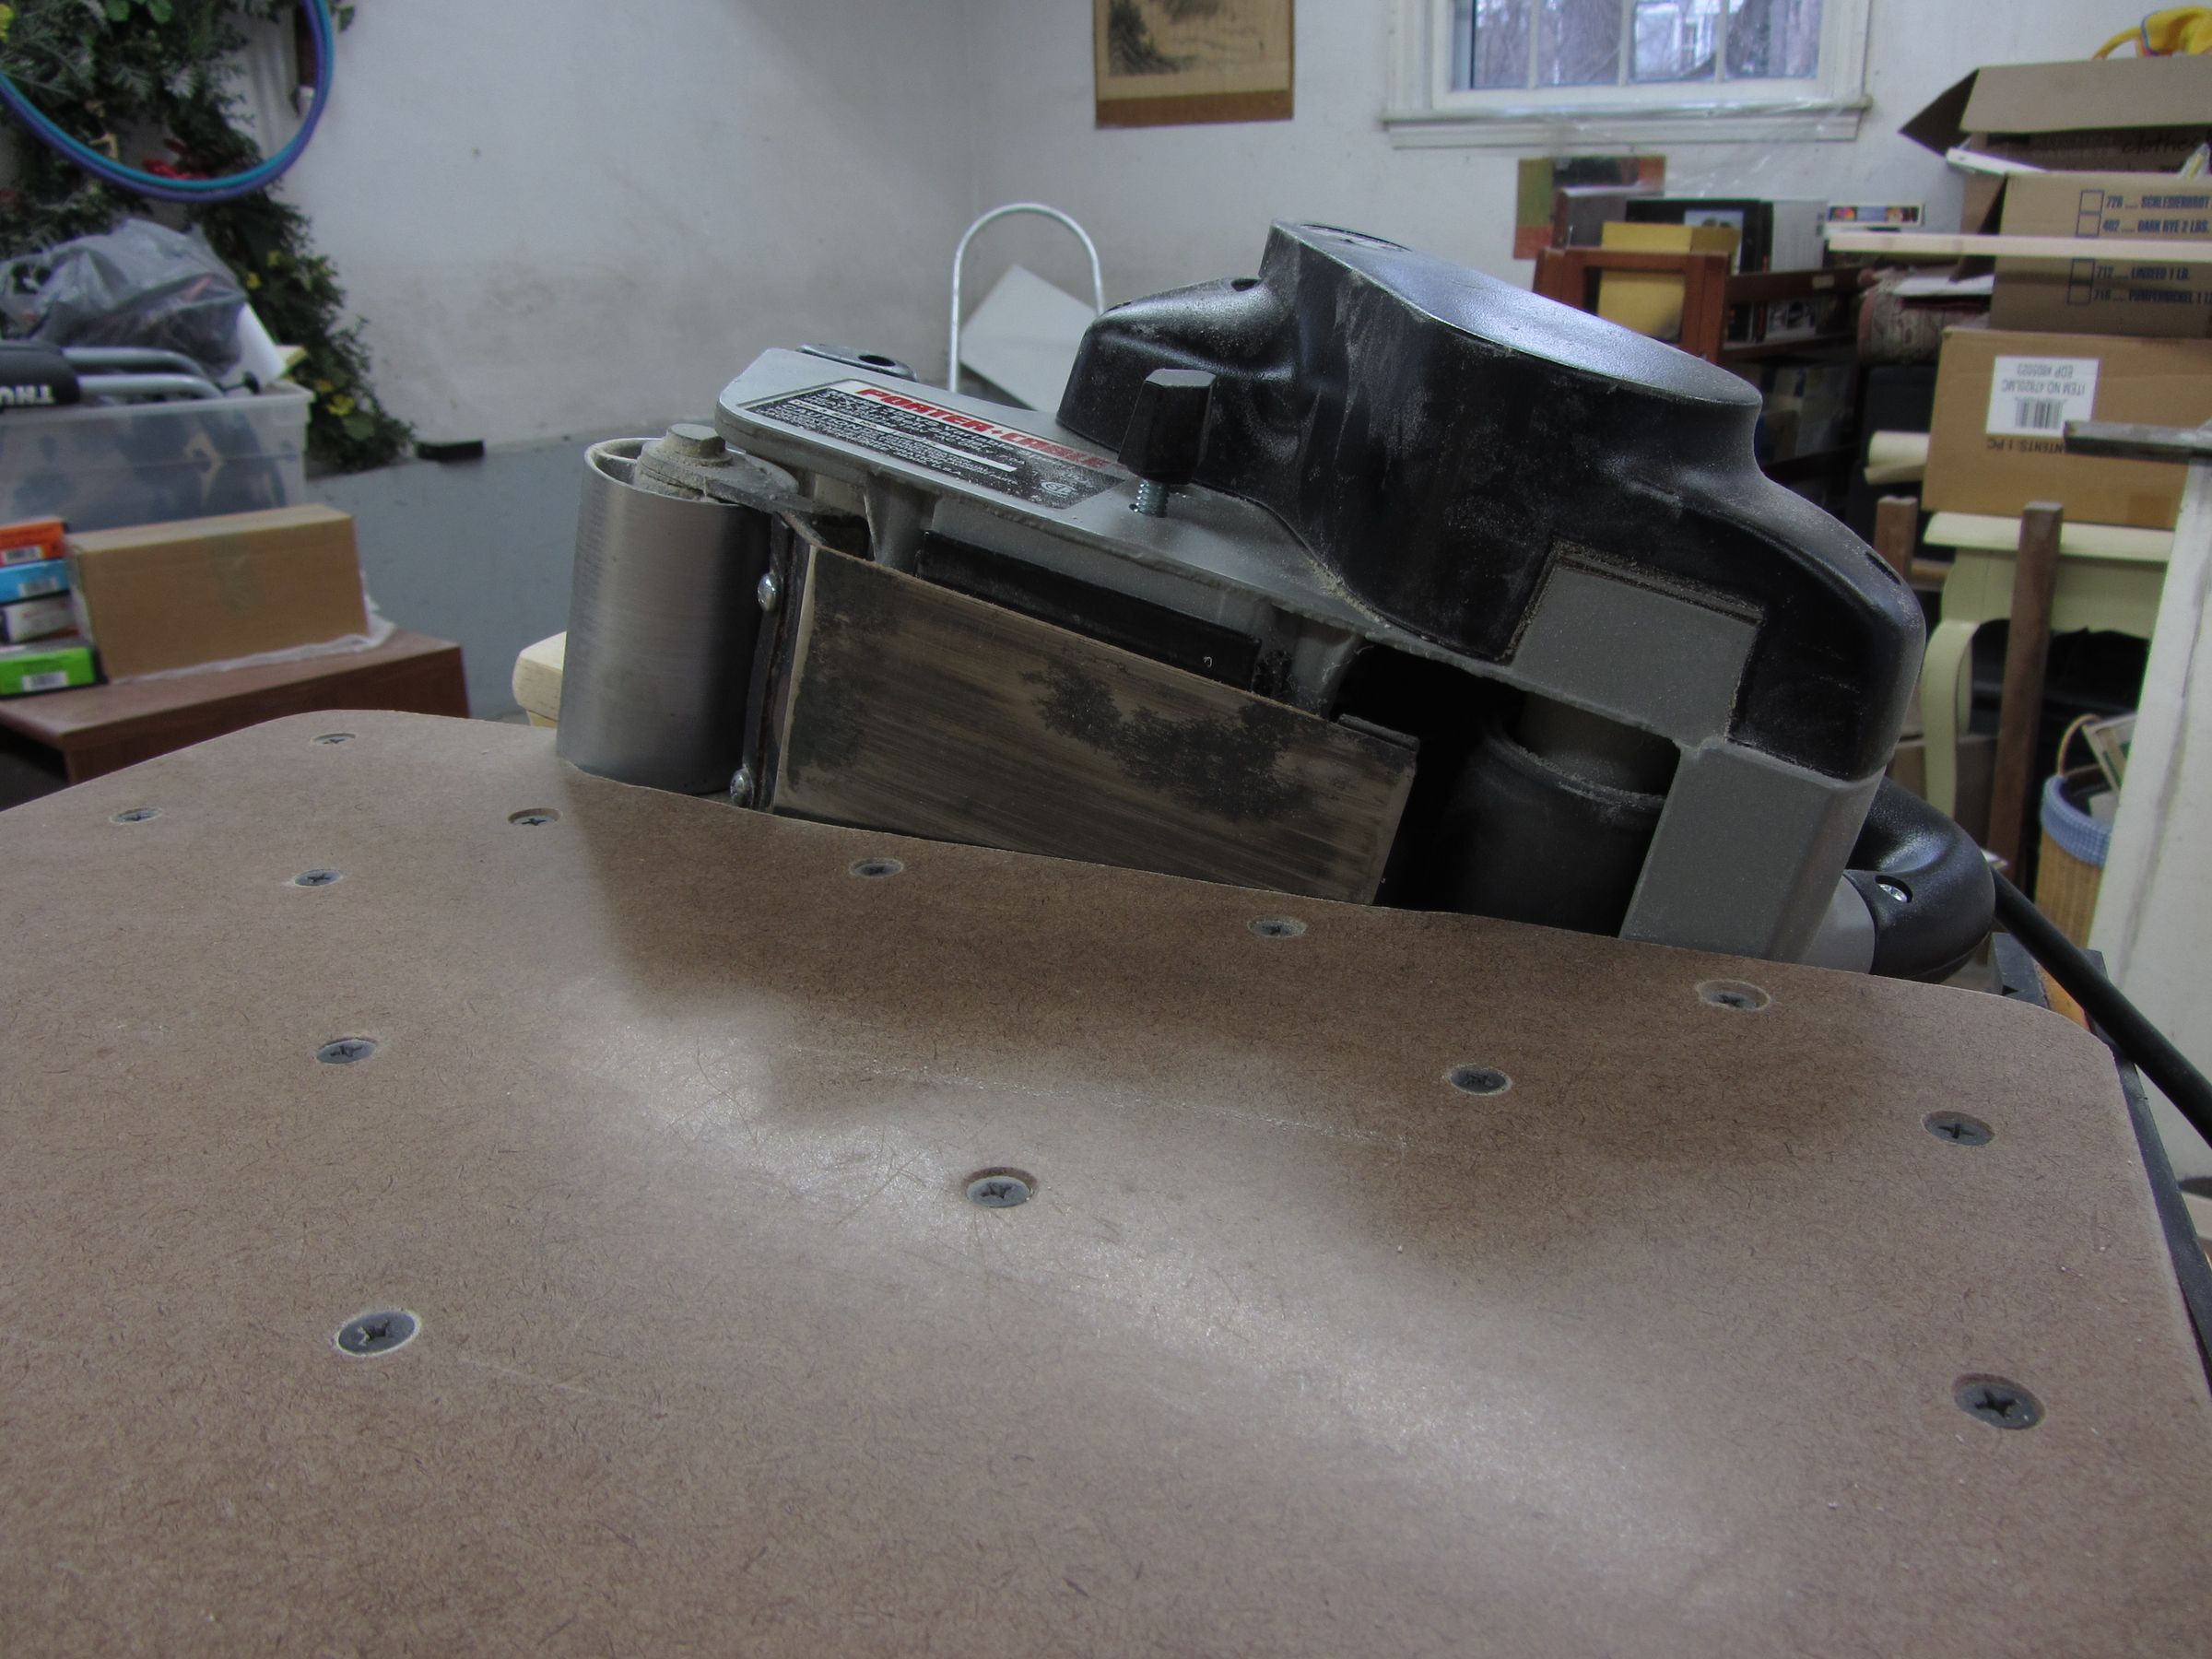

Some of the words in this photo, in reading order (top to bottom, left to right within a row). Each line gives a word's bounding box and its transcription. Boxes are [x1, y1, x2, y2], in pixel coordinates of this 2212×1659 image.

[2137, 218, 2160, 233] DARK
[2162, 219, 2179, 233] RYE
[2063, 381, 2086, 395] ITEM
[887, 415, 927, 428] Belt
[924, 427, 994, 449] Sander
[938, 426, 1018, 451] Variable
